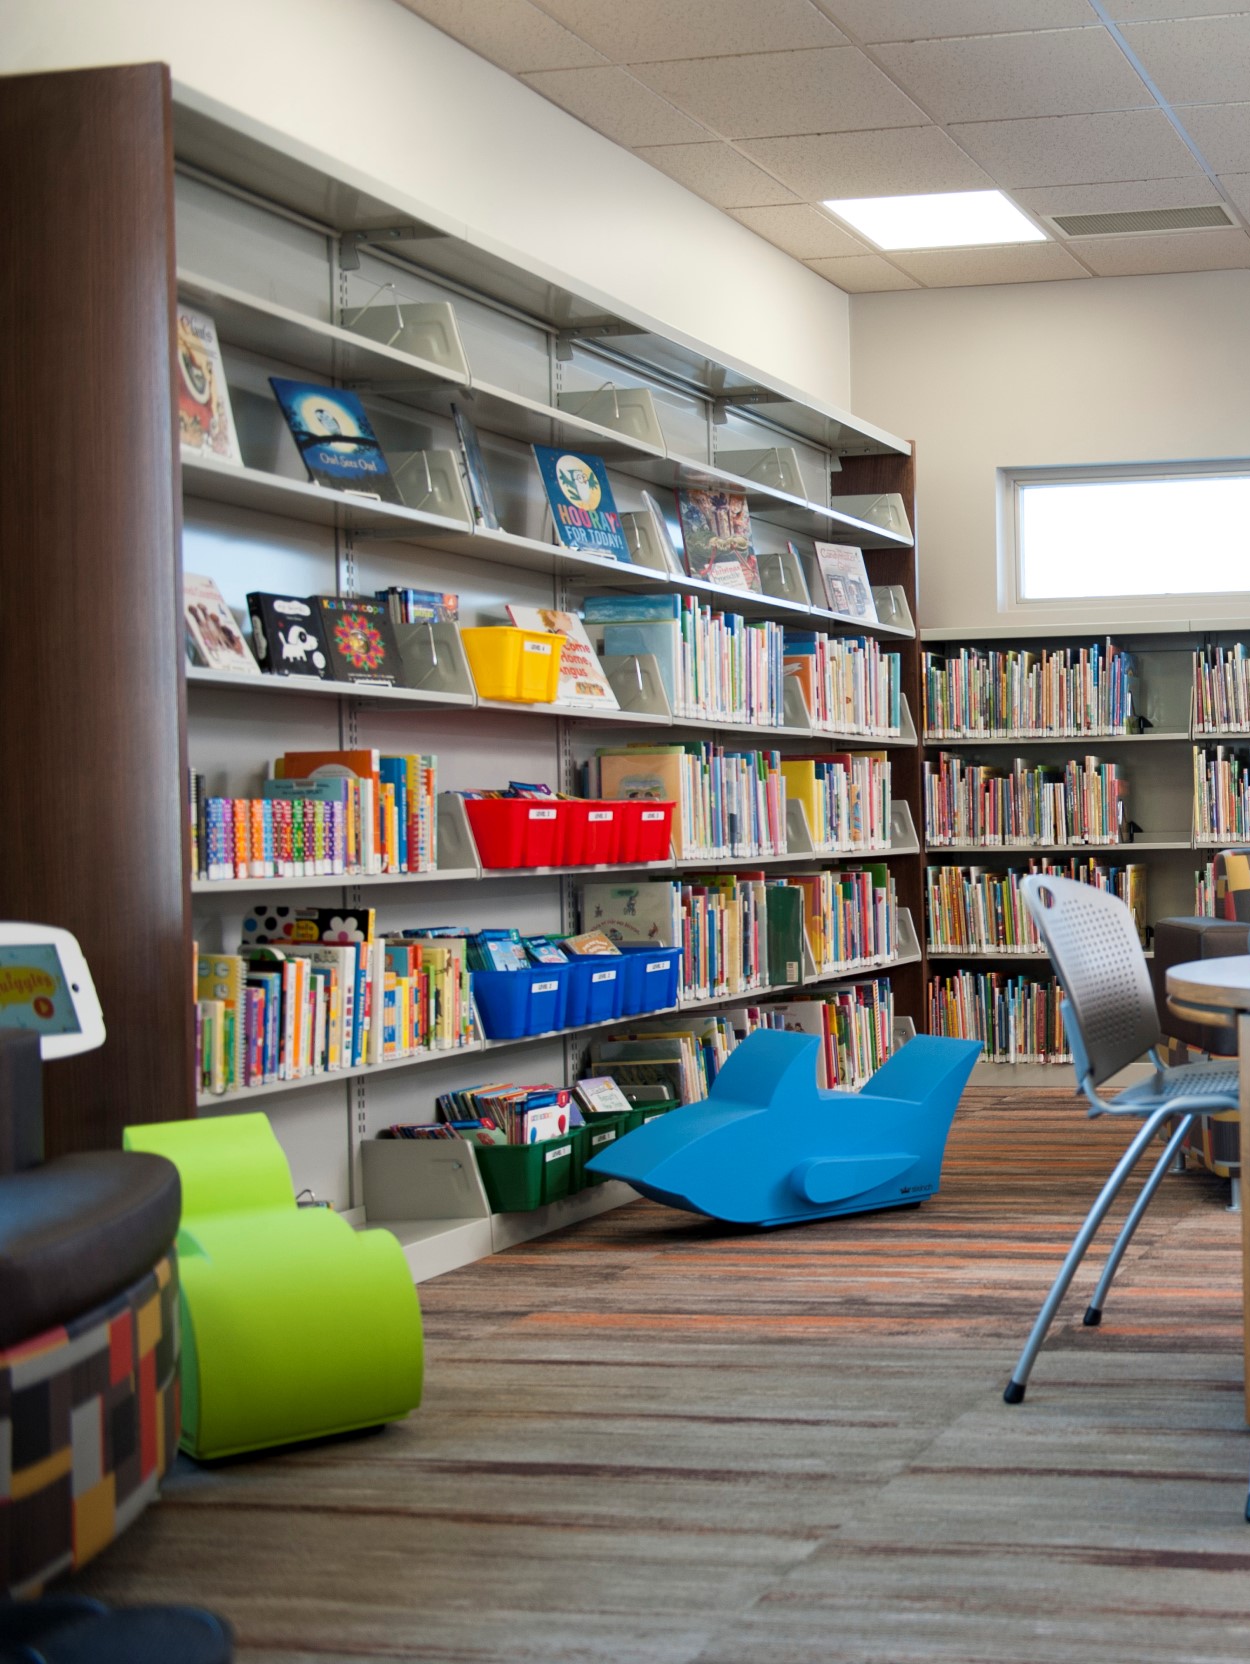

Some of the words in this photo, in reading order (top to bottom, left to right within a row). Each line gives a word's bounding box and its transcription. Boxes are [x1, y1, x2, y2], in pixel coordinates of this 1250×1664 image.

[319, 452, 340, 465] Owl
[358, 458, 378, 472] Owl
[565, 525, 588, 543] FOR
[587, 528, 624, 550] TODAY!
[322, 599, 386, 616] Kaleidoscope
